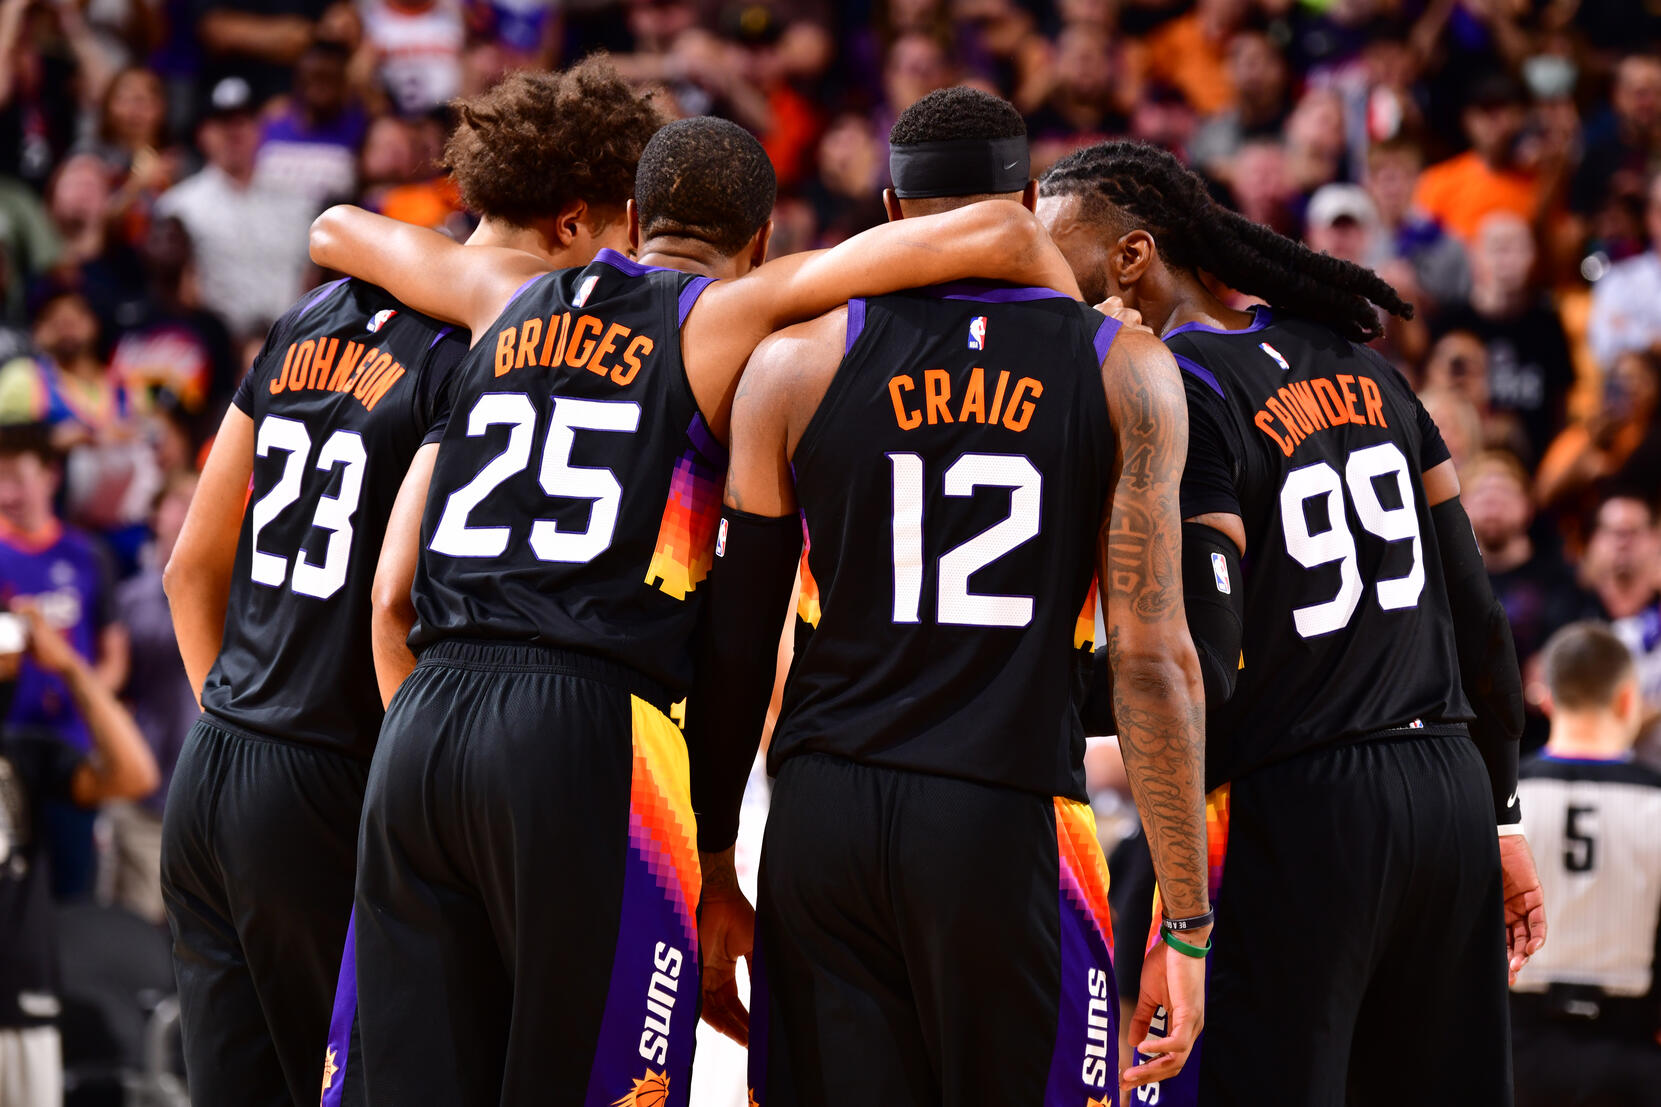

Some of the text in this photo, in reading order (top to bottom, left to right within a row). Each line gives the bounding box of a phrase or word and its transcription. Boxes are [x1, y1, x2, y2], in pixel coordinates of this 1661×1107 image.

[269, 335, 406, 412] JOHNSON
[494, 311, 655, 387] BRIDGES
[888, 366, 1045, 432] CRAIG
[1253, 373, 1388, 458] CROWDER
[250, 414, 368, 600] 23
[427, 391, 642, 563] 25
[885, 452, 1042, 628] 12
[1279, 441, 1426, 638] 99
[1564, 804, 1597, 874] 5
[638, 941, 683, 1065] SUNS
[1081, 967, 1108, 1088] SUNS
